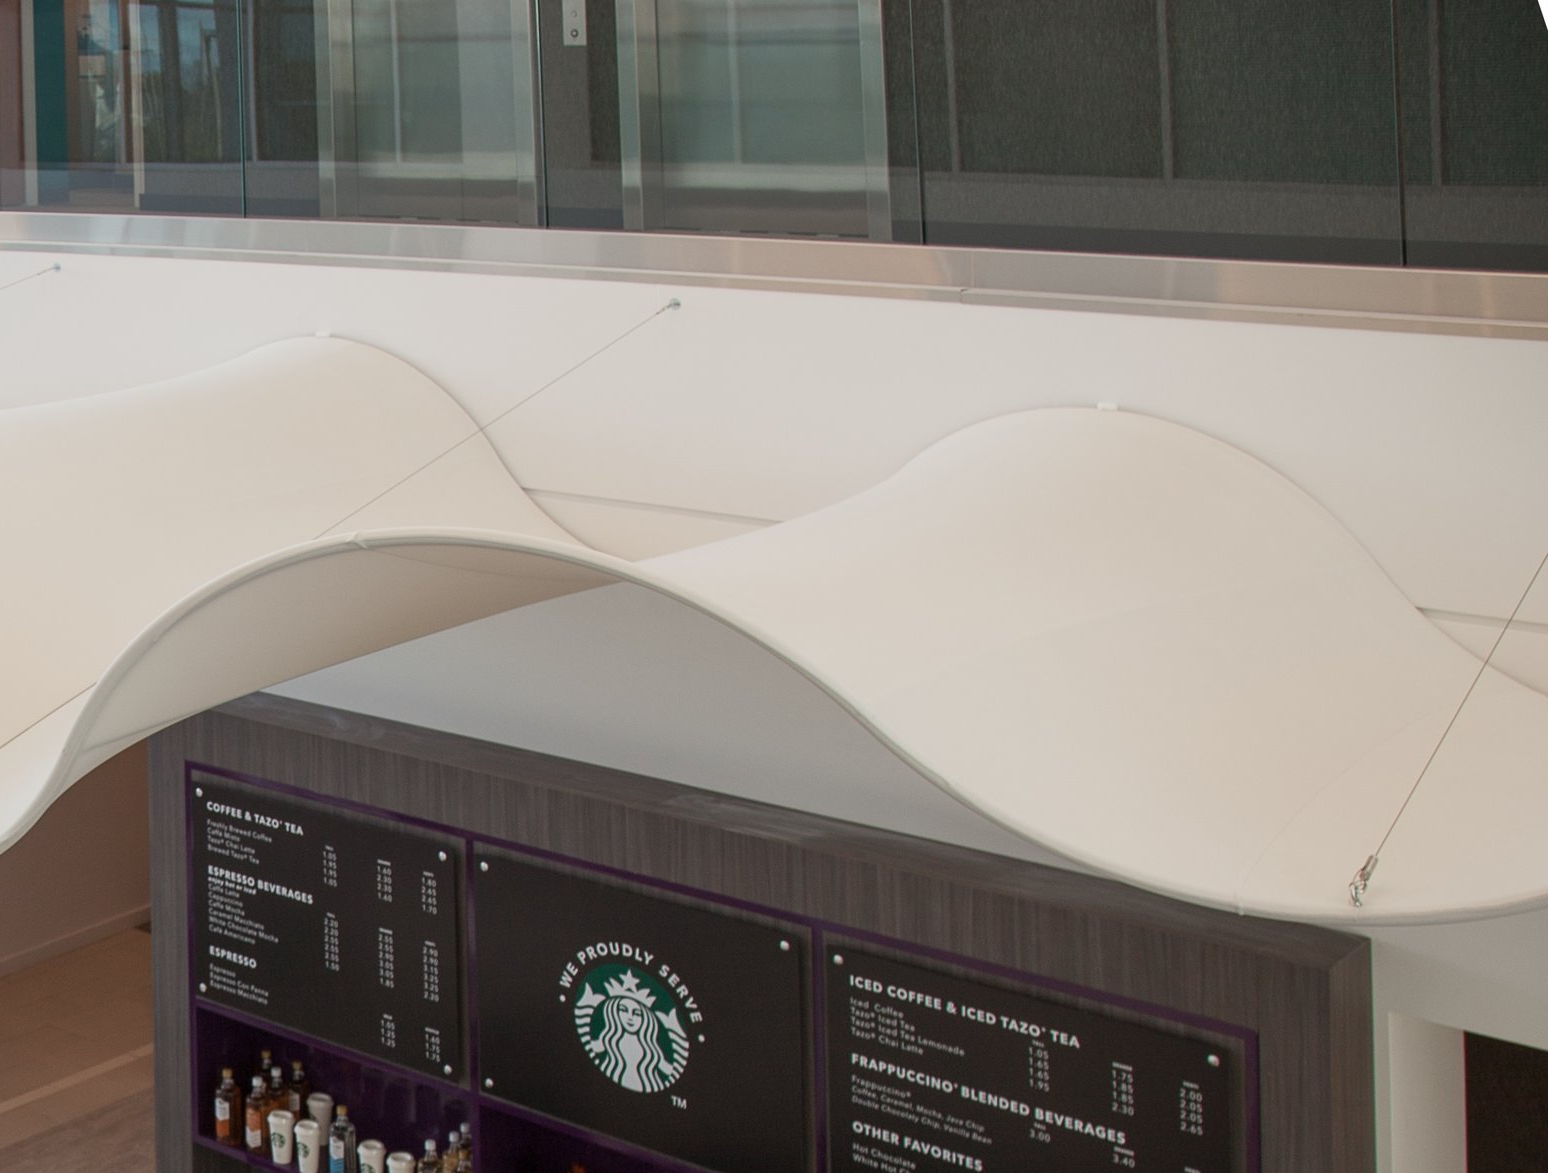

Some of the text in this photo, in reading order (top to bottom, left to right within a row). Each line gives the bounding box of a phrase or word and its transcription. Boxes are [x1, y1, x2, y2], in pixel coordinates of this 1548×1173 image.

[206, 801, 242, 819] COFFEE
[244, 811, 252, 821] &
[284, 821, 304, 836] TEA
[206, 818, 272, 843] Freshly Brewed Coffee
[207, 843, 230, 856] Brewed
[248, 854, 260, 864] Tea
[225, 839, 239, 849] Chai
[240, 844, 255, 854] Latte
[207, 864, 313, 904] ESPRESSO BEVERAGES
[207, 876, 224, 886] enjoy
[224, 880, 235, 888] hot
[243, 886, 257, 895] iced
[224, 888, 240, 898] Latte
[376, 882, 392, 893] 2.30
[208, 907, 264, 930] Caramel Macchiato
[224, 904, 245, 916] Mocha
[422, 903, 437, 915] 1.70
[208, 915, 279, 943] White Chocolate Mocha
[223, 928, 256, 945] Americano
[209, 945, 257, 969] ESPRESSO
[209, 962, 236, 978] Espresso
[209, 971, 236, 986] Espresso
[236, 980, 249, 990] Con
[559, 942, 703, 1024] WE PROUDLY SERVE
[209, 979, 268, 1005] Espresso Macchiato
[849, 996, 904, 1019] Iced Coffee
[849, 974, 883, 993] ICED
[886, 985, 942, 1010] COFFEE
[946, 1001, 957, 1014] &
[961, 1005, 996, 1025] ICED
[1050, 1029, 1080, 1049] TEA
[878, 1014, 898, 1027] Iced
[900, 1020, 915, 1032] Tea
[878, 1024, 898, 1037] Iced
[900, 1029, 916, 1042] Tea
[917, 1035, 965, 1056] Lemonade
[878, 1034, 899, 1047] Chai
[900, 1041, 924, 1055] Latte
[1028, 1046, 1049, 1060] 1.05
[1028, 1056, 1049, 1070] 1.65
[1029, 1067, 1050, 1081] 1.65
[1111, 1069, 1134, 1084] 1.75
[1029, 1078, 1050, 1092] 1.95
[1179, 1087, 1203, 1103] 2.00
[851, 1084, 878, 1099] Coffee,
[945, 1114, 964, 1126] Java
[965, 1119, 985, 1133] Chip
[960, 1085, 1030, 1116] BLENDED
[1034, 1107, 1126, 1144] BEVERAGES
[1111, 1101, 1134, 1116] 2.30
[1179, 1098, 1203, 1113] 2.05
[851, 1094, 880, 1110] Double
[943, 1123, 970, 1138] Vanilla
[971, 1131, 992, 1144] Bean
[1180, 1109, 1203, 1124] 2.05
[1029, 1128, 1051, 1143] 3.00
[1180, 1121, 1203, 1136] 2.65
[852, 1120, 983, 1172] OTHER FAVORITES
[852, 1142, 916, 1170] Hot Chocolate
[852, 1153, 879, 1168] White
[880, 1162, 897, 1173] Hot
[1113, 1153, 1135, 1168] 3.40
